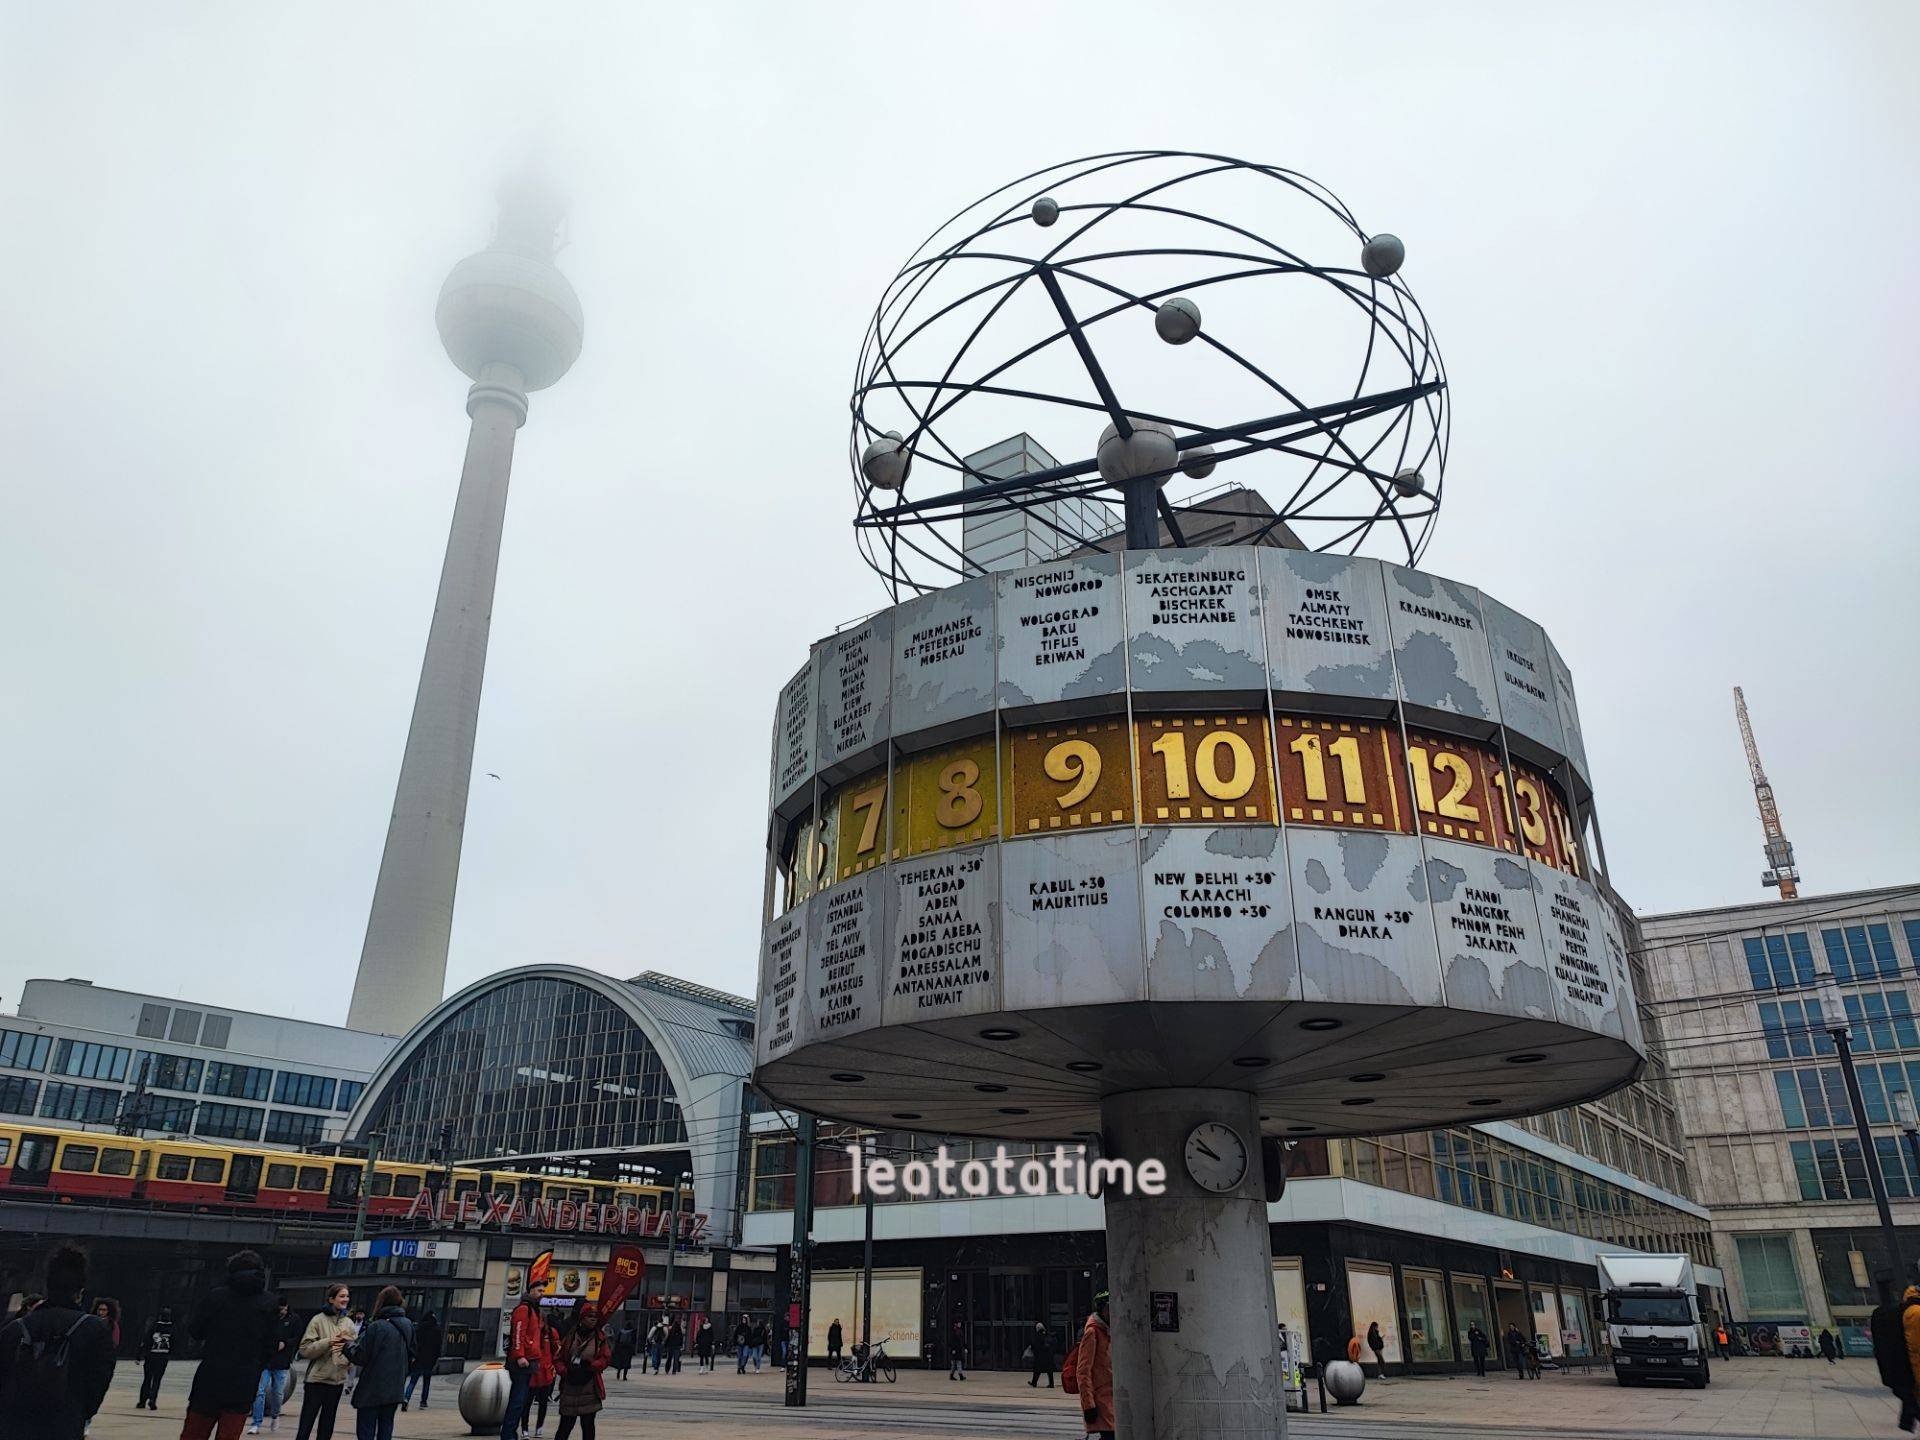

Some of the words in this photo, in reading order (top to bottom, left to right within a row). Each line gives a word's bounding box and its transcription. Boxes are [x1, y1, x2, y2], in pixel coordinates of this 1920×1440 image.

[1014, 570, 1074, 589] NISCHNIJ
[1136, 570, 1245, 584] JEKATERINBURG
[1035, 579, 1103, 598] NOWGOROD
[1151, 585, 1233, 597] ASCHGABAT
[1306, 588, 1341, 601] OMSK
[1159, 598, 1225, 611] BISCHKEK
[1300, 601, 1350, 616] ALMATY
[1020, 606, 1099, 627] WOLGOGRAD
[1152, 612, 1236, 625] DUSCHANBE
[1289, 614, 1364, 631] TASCHKENT
[1399, 600, 1474, 630] KRASNOJARSK
[912, 615, 974, 644] MURMANSK
[1042, 623, 1076, 638] BAKU
[1286, 627, 1372, 646] NOWOSIBIRSK
[838, 628, 872, 654] HELSINKI
[904, 647, 917, 659] ST.
[919, 626, 982, 655] PETERSBURG
[1040, 636, 1079, 651] TIFLIS
[845, 646, 862, 662] RIGA
[920, 645, 965, 667] MOSKAU
[1035, 649, 1085, 666] ERIWAN
[1506, 649, 1536, 674] IRKUTSK
[839, 654, 869, 677] TALLINN
[842, 668, 865, 688] WILNA
[841, 680, 865, 701] MINSK
[843, 694, 862, 712] KIEW
[833, 702, 872, 730] BUKAREST
[841, 719, 862, 739] SOFIA
[836, 731, 866, 754] NIKOSIA
[1043, 739, 1102, 809] 9
[1152, 730, 1257, 800] 10
[1291, 733, 1367, 805] 11
[935, 758, 983, 828] 8
[1407, 746, 1480, 824] 12
[853, 779, 888, 855] 7
[1494, 769, 1547, 848] 13
[900, 864, 954, 885] TEHERAN
[1154, 872, 1185, 885] NEW
[1195, 872, 1238, 885] DELHI
[918, 878, 965, 897] BAGDAD
[1029, 879, 1076, 895] KABUL
[1180, 889, 1252, 902] KARACHI
[1465, 887, 1501, 905] HANOI
[828, 886, 863, 909] ANKARA
[925, 894, 958, 912] ADEN
[1032, 892, 1108, 911] MAURITIUS
[1554, 893, 1580, 913] PEKING
[826, 900, 864, 925] ISTANBUL
[919, 910, 963, 928] SANAA
[1163, 905, 1232, 919] COLOMBO
[1313, 907, 1375, 922] RANGUN
[1460, 902, 1512, 923] BANGKOK
[1550, 906, 1590, 931] SHANGHAI
[830, 917, 857, 937] ATHEN
[901, 929, 936, 947] ADDIS
[942, 922, 982, 940] ABEBA
[1338, 925, 1393, 940] DHAKA
[1451, 915, 1491, 935] PHNOM
[1496, 923, 1526, 940] PENH
[1558, 922, 1588, 944] MANILA
[826, 939, 838, 953] TEL
[842, 931, 861, 948] AVIV
[901, 938, 981, 963] MOGADISCHU
[1465, 935, 1518, 955] JAKARTA
[1565, 939, 1588, 958] PERTH
[820, 944, 866, 969] JERUSALEM
[900, 954, 981, 978] DARESSALAM
[1559, 952, 1599, 976] HONGKONG
[828, 962, 855, 981] BEIRUT
[1554, 965, 1580, 985] KUALA
[820, 974, 864, 999] DAMASKUS
[893, 969, 990, 996] ANTANANARIVO
[827, 993, 852, 1012] KAIRO
[918, 990, 963, 1008] KUWAIT
[1567, 985, 1604, 1008] SINGAPUR
[820, 1006, 861, 1029] KAPSTADT
[407, 1187, 709, 1240] ALEXANDERPLATZ
[391, 1240, 403, 1256] U
